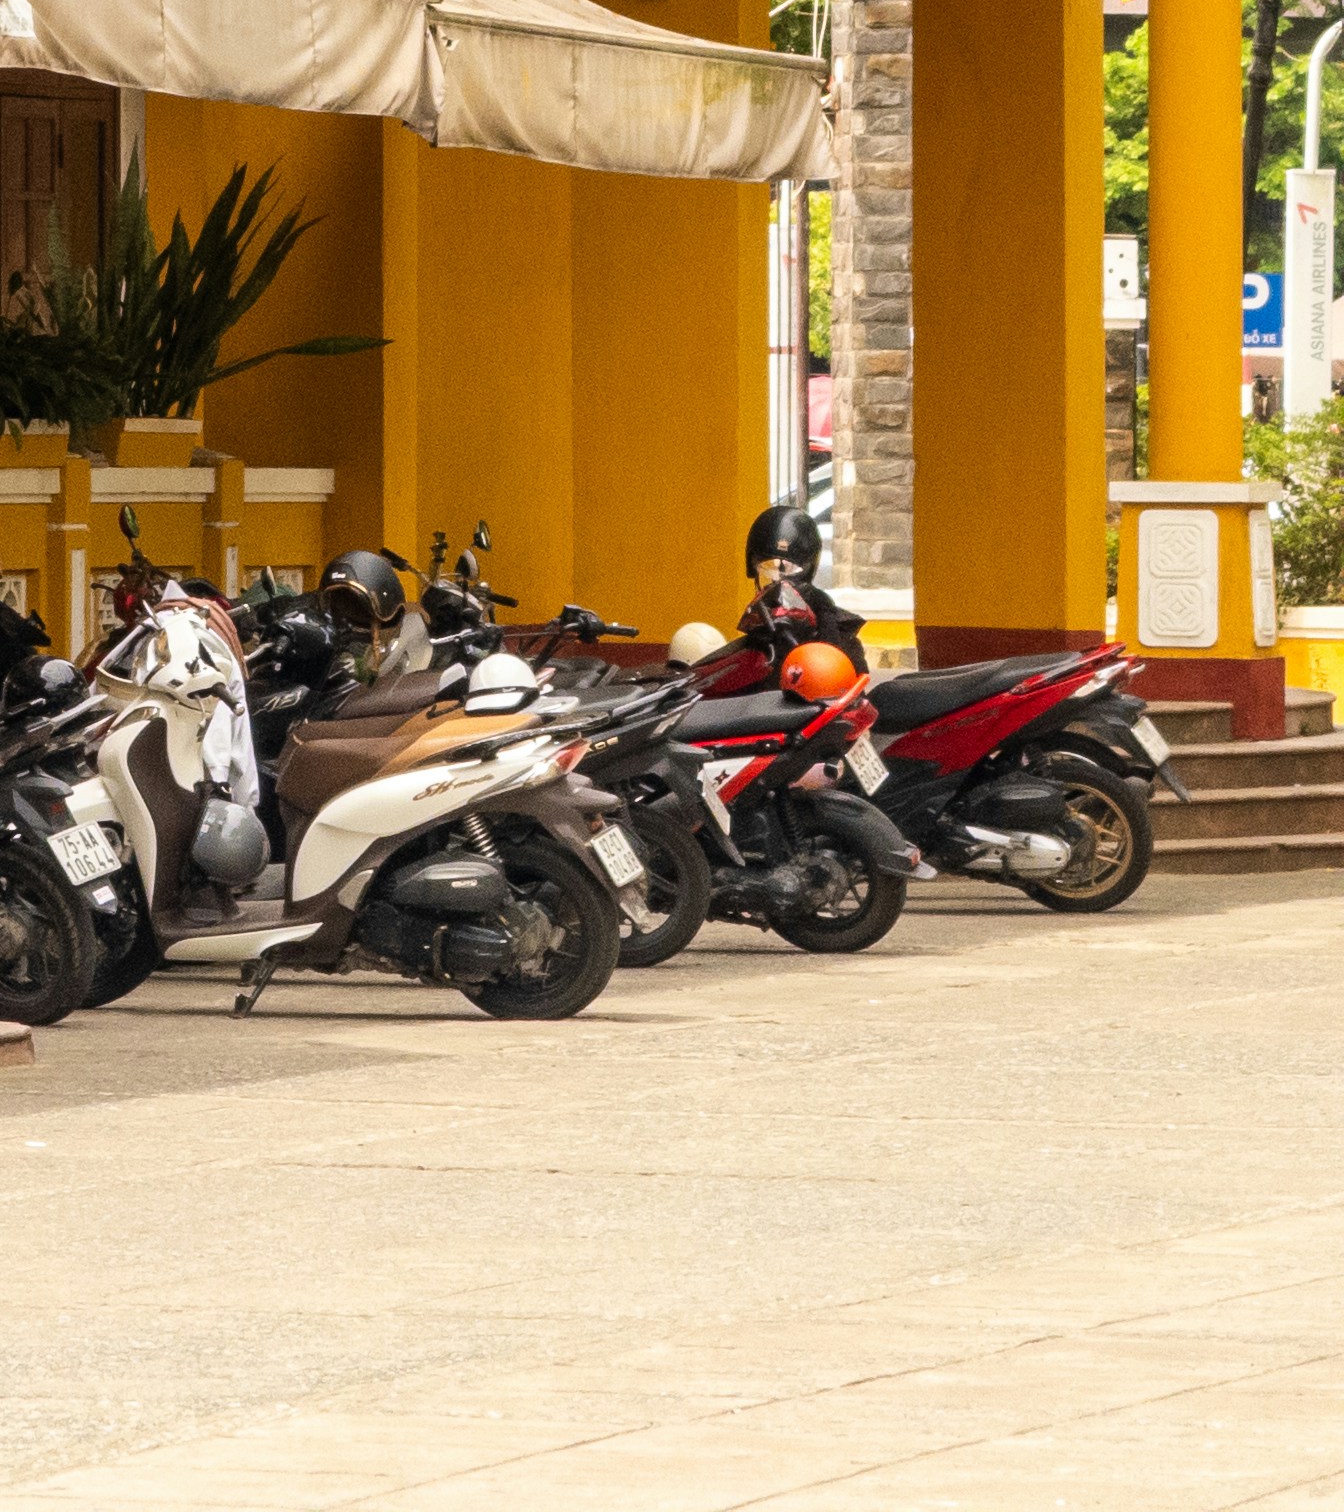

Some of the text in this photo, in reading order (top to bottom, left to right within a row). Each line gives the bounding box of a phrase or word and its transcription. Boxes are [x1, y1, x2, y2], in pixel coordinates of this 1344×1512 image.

[1310, 220, 1327, 362] ASIANA AIRLINES
[1263, 332, 1277, 344] XE
[57, 828, 100, 859] 75-AA
[66, 847, 116, 881] 106.44
